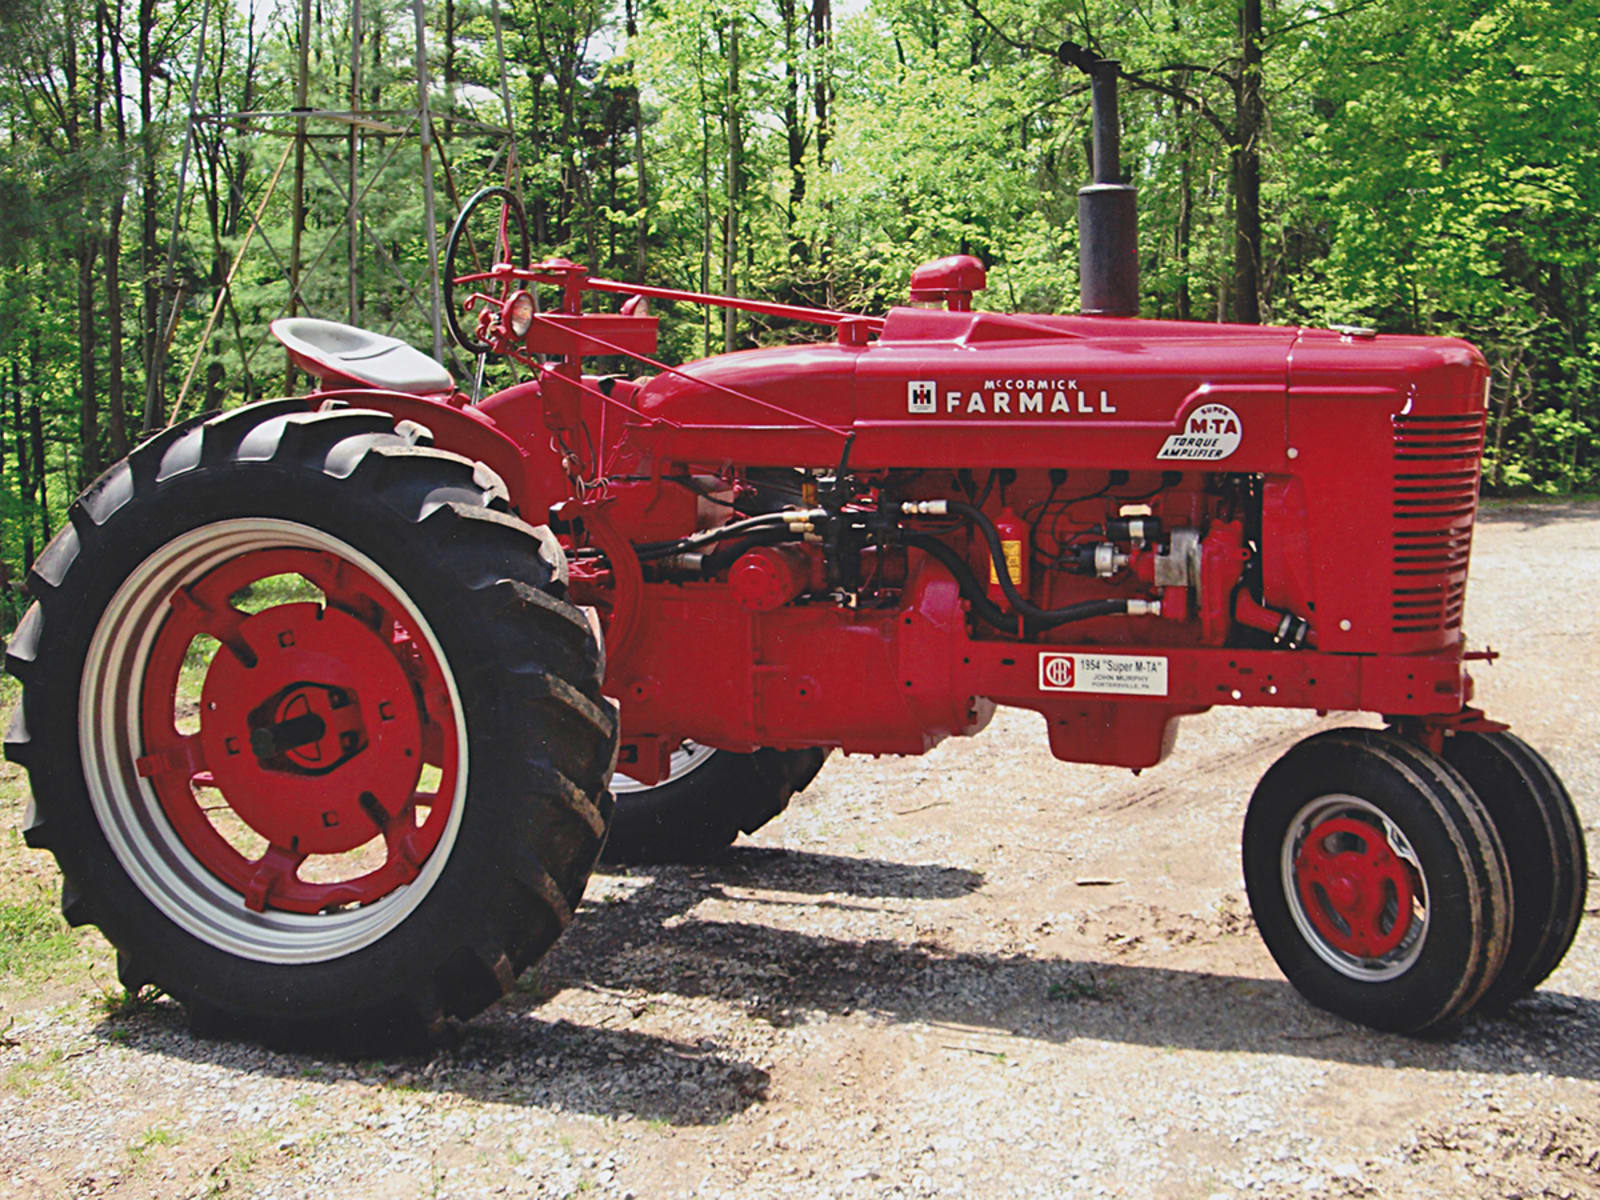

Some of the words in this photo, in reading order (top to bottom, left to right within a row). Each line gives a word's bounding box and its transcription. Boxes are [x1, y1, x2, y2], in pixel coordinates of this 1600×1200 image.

[946, 391, 1117, 414] FARMALL
[1201, 406, 1228, 416] SUPER
[1173, 437, 1219, 448] TORQUE
[1162, 448, 1223, 458] AMPLIFIER
[1080, 659, 1100, 671] 1954
